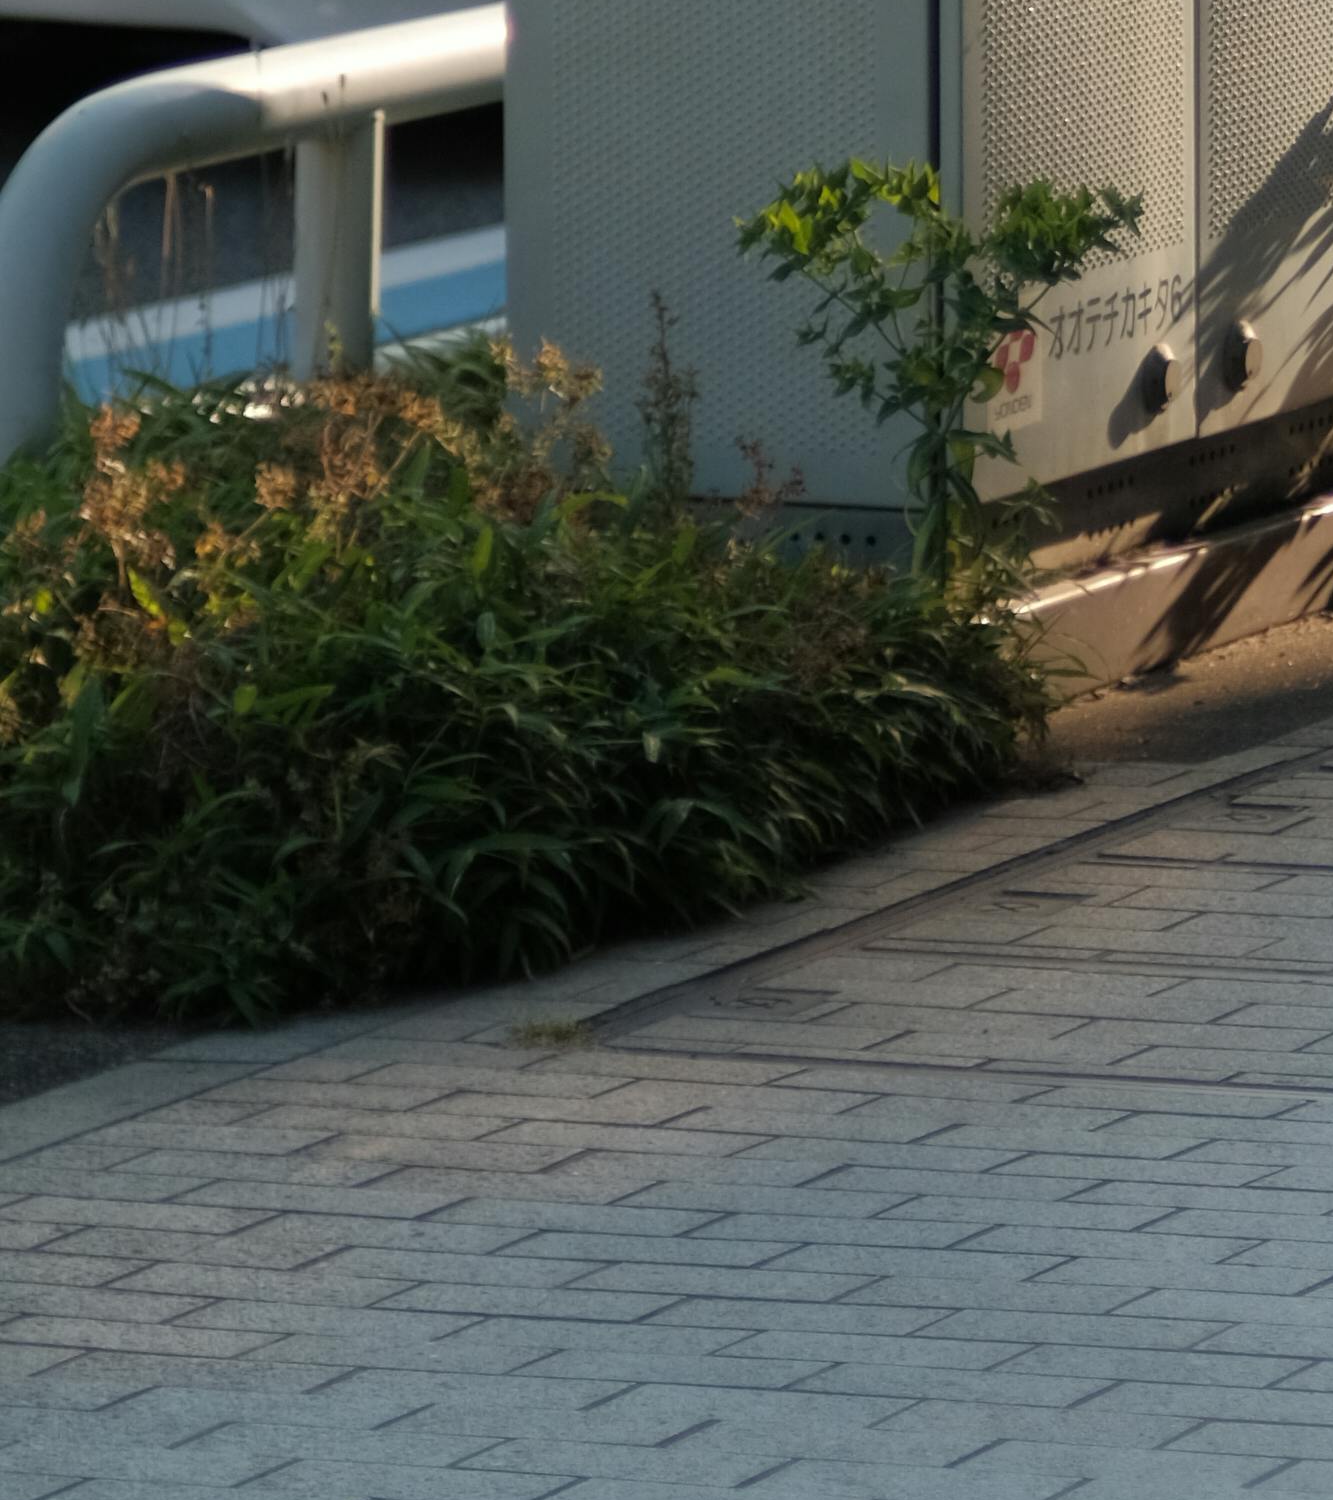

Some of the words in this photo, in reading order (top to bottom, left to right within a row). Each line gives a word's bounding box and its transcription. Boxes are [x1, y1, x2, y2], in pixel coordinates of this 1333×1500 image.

[1048, 273, 1182, 359] オオテチカキタ6
